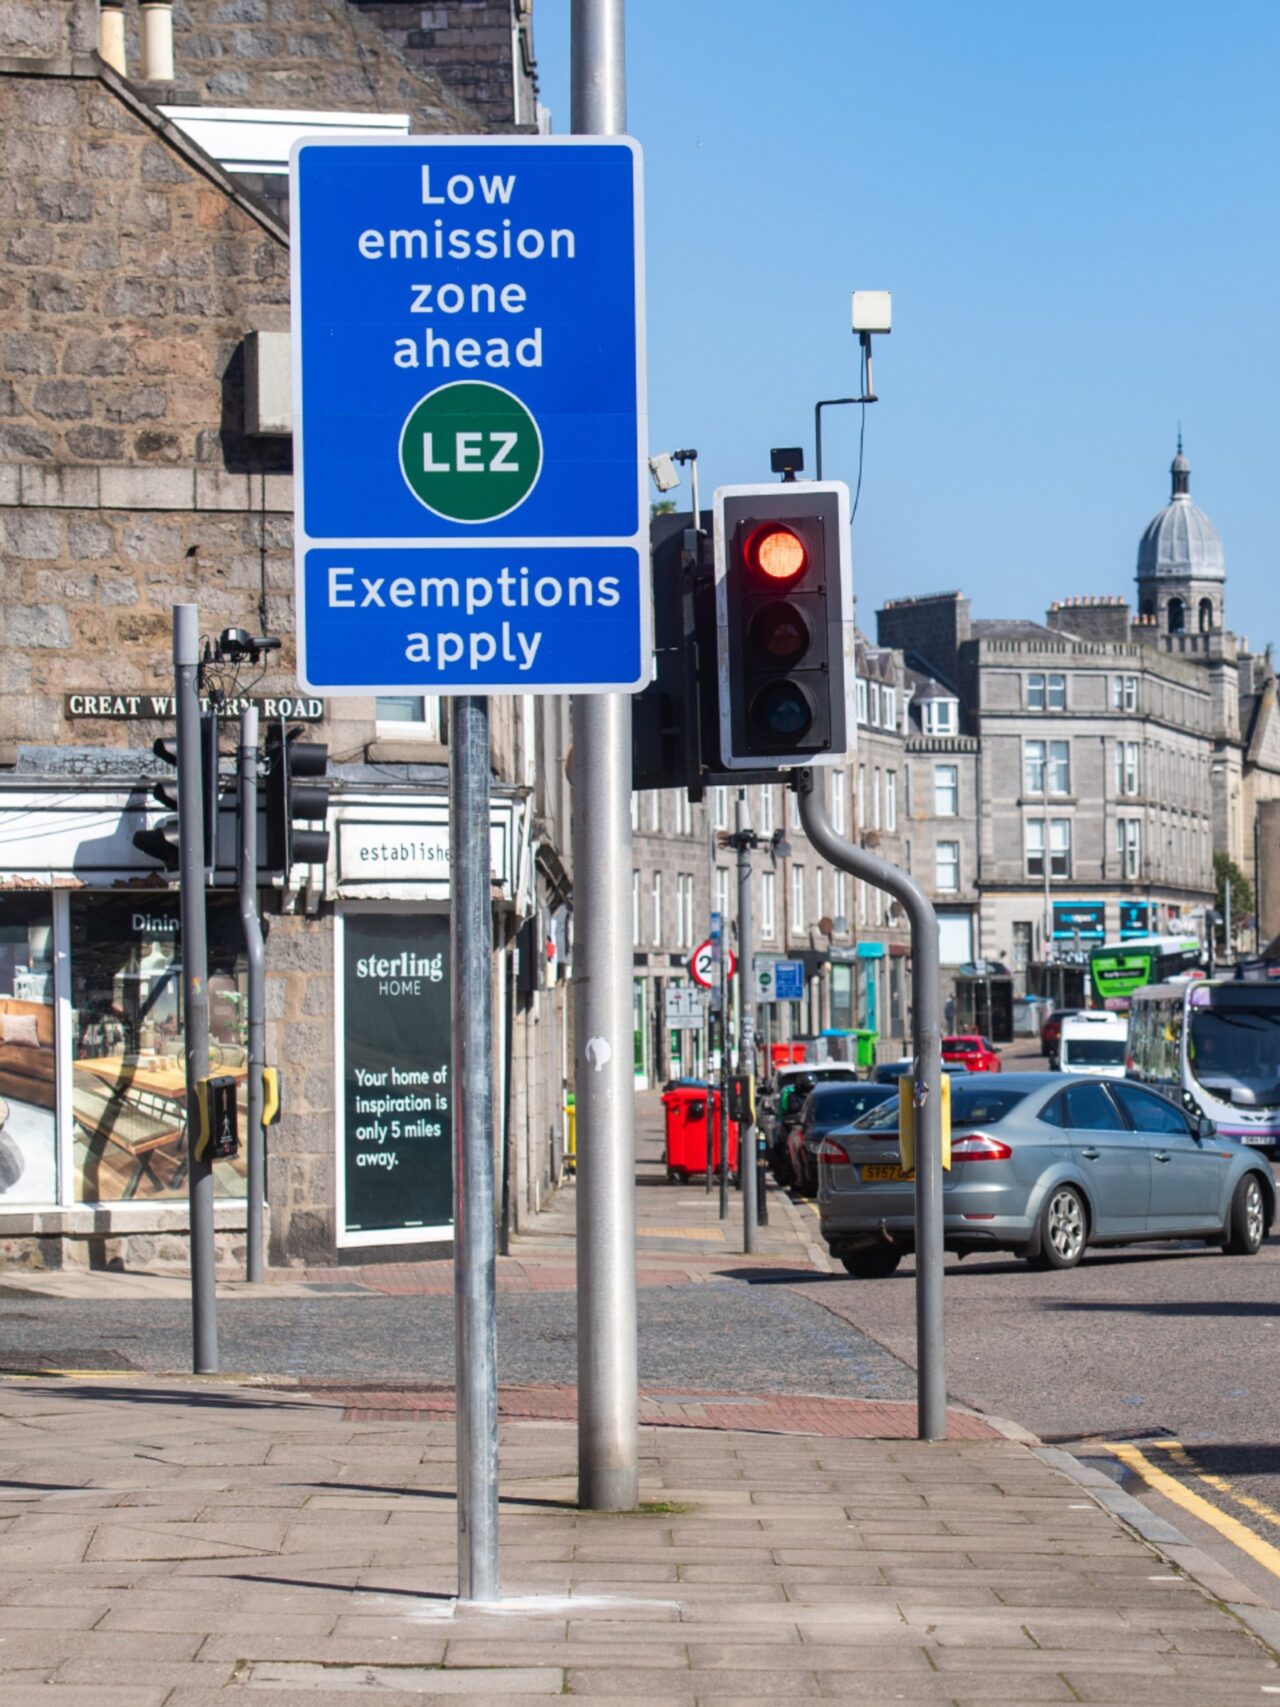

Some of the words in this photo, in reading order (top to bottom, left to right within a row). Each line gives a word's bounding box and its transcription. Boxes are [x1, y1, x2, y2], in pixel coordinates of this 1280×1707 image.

[422, 165, 516, 205] Low
[358, 219, 575, 259] emission
[410, 284, 526, 313] zone
[393, 328, 543, 368] ahead
[423, 432, 519, 472] LEZ
[328, 567, 620, 615] Exemptions
[405, 622, 542, 670] apply
[69, 695, 141, 715] GREAT
[264, 699, 322, 717] ROAD
[356, 951, 443, 982] sterling
[379, 980, 421, 996] HOME
[355, 1068, 388, 1086] Your
[391, 1066, 430, 1085] home
[433, 1065, 448, 1084] of
[355, 1093, 432, 1118] inspiration
[436, 1092, 448, 1110] is
[356, 1120, 388, 1144] only
[391, 1120, 401, 1138] 5
[404, 1118, 442, 1138] miles
[356, 1152, 399, 1170] away.
